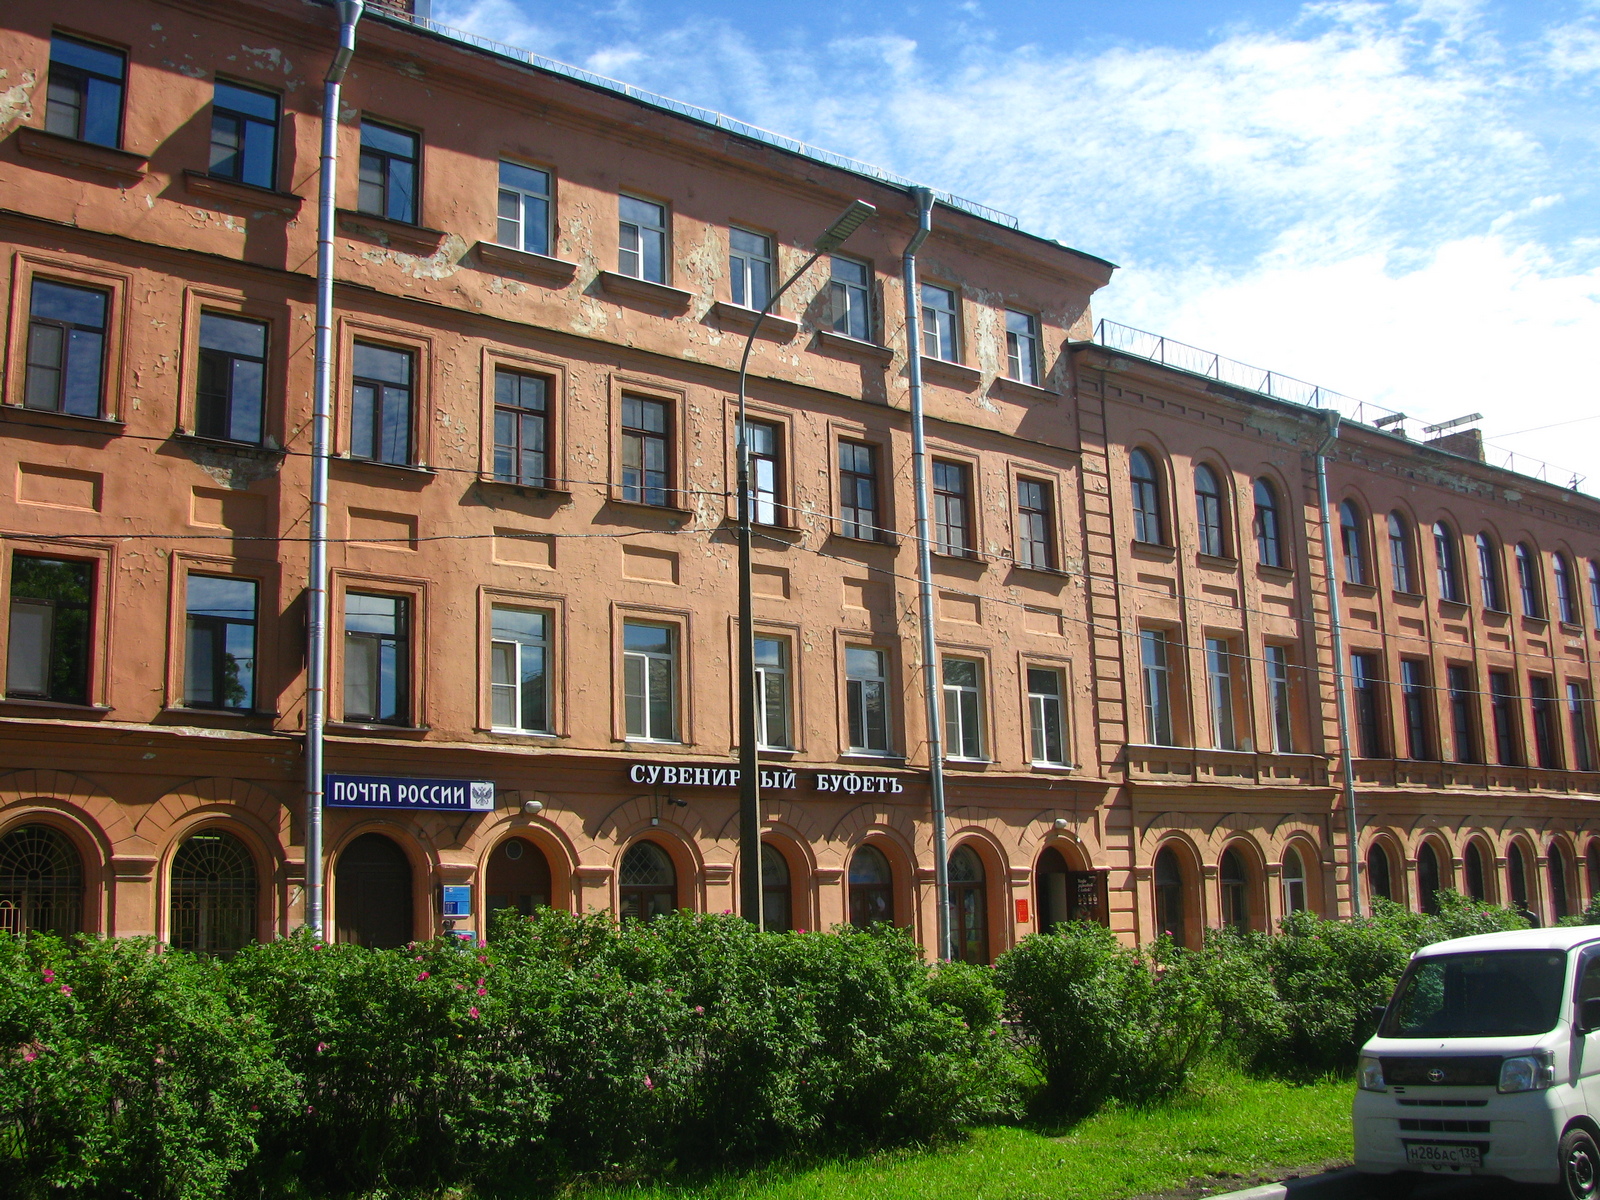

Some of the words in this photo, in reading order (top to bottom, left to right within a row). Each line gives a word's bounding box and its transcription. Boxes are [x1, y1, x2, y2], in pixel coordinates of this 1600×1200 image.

[630, 764, 797, 789] СУВЕНИРЫЙ
[816, 773, 903, 794] БУФЕТЪ
[334, 782, 391, 802] ПОЧТА
[398, 785, 465, 805] РОССИИ
